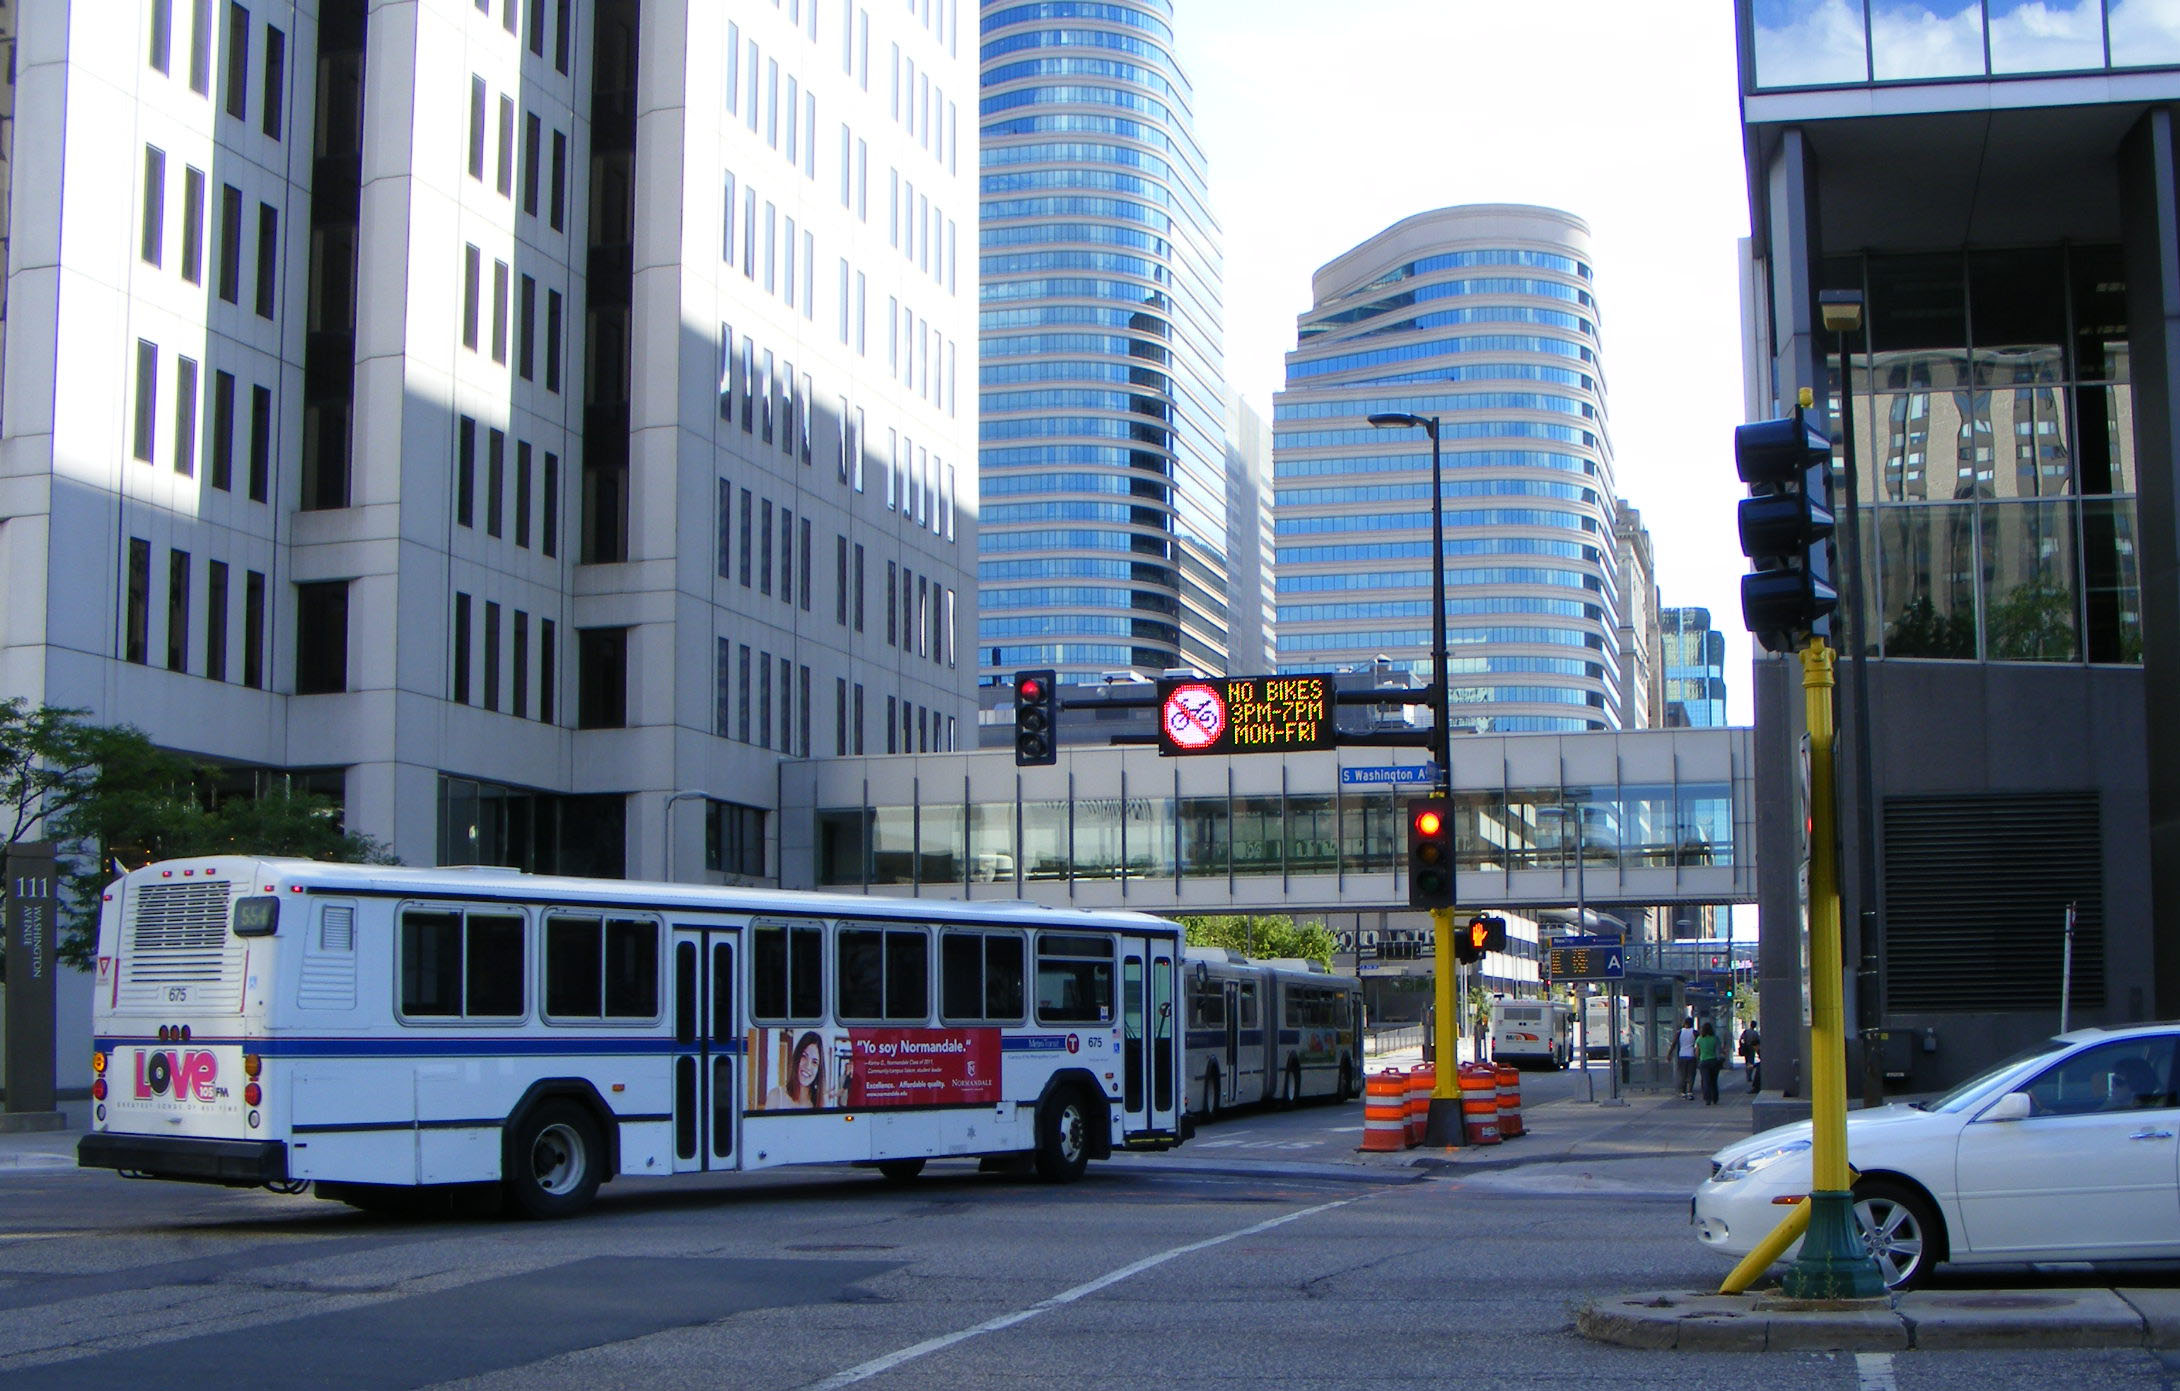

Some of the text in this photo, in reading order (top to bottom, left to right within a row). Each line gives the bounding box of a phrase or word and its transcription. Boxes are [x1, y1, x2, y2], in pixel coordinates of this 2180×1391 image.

[1228, 680, 1323, 702] NO BIKES
[1231, 700, 1323, 723] 3PM-7PM
[1234, 722, 1316, 744] MON-FRI
[1343, 770, 1350, 781] S
[1355, 768, 1413, 783] Washington
[17, 877, 48, 898] 111
[24, 905, 33, 946] AVENUE
[33, 905, 42, 978] WASHINGTON
[1607, 955, 1621, 969] A
[169, 987, 187, 1002] 675
[1088, 1037, 1103, 1048] 675
[879, 1043, 898, 1058] soy
[215, 1087, 229, 1098] FM
[899, 1081, 926, 1089] Affordable
